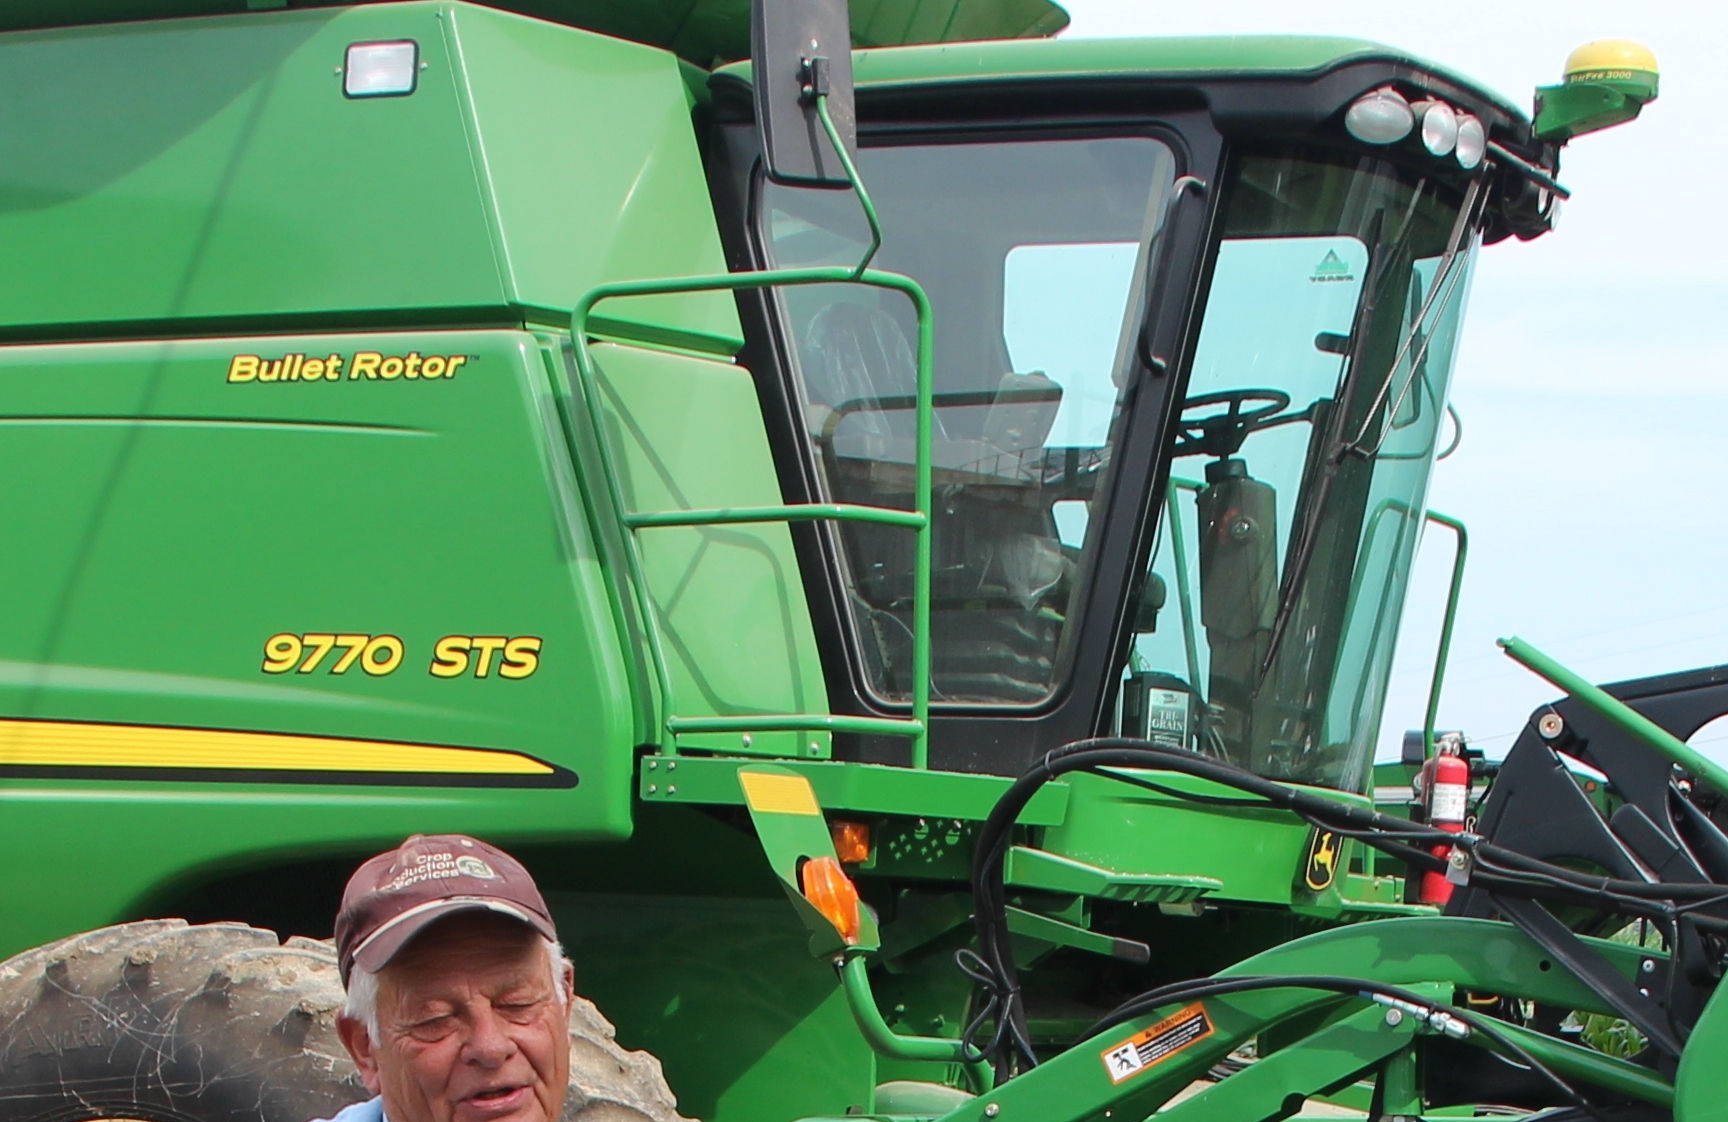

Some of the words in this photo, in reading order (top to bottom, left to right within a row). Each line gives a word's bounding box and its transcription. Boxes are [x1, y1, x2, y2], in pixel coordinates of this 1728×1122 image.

[1605, 71, 1632, 80] 3000
[226, 353, 344, 384] Bullet
[347, 351, 469, 382] Rotor
[261, 632, 405, 677] 9770
[429, 634, 543, 680] STS
[1152, 718, 1183, 731] GRAIN
[416, 852, 452, 865] Crop
[1152, 1009, 1192, 1034] WARNING
